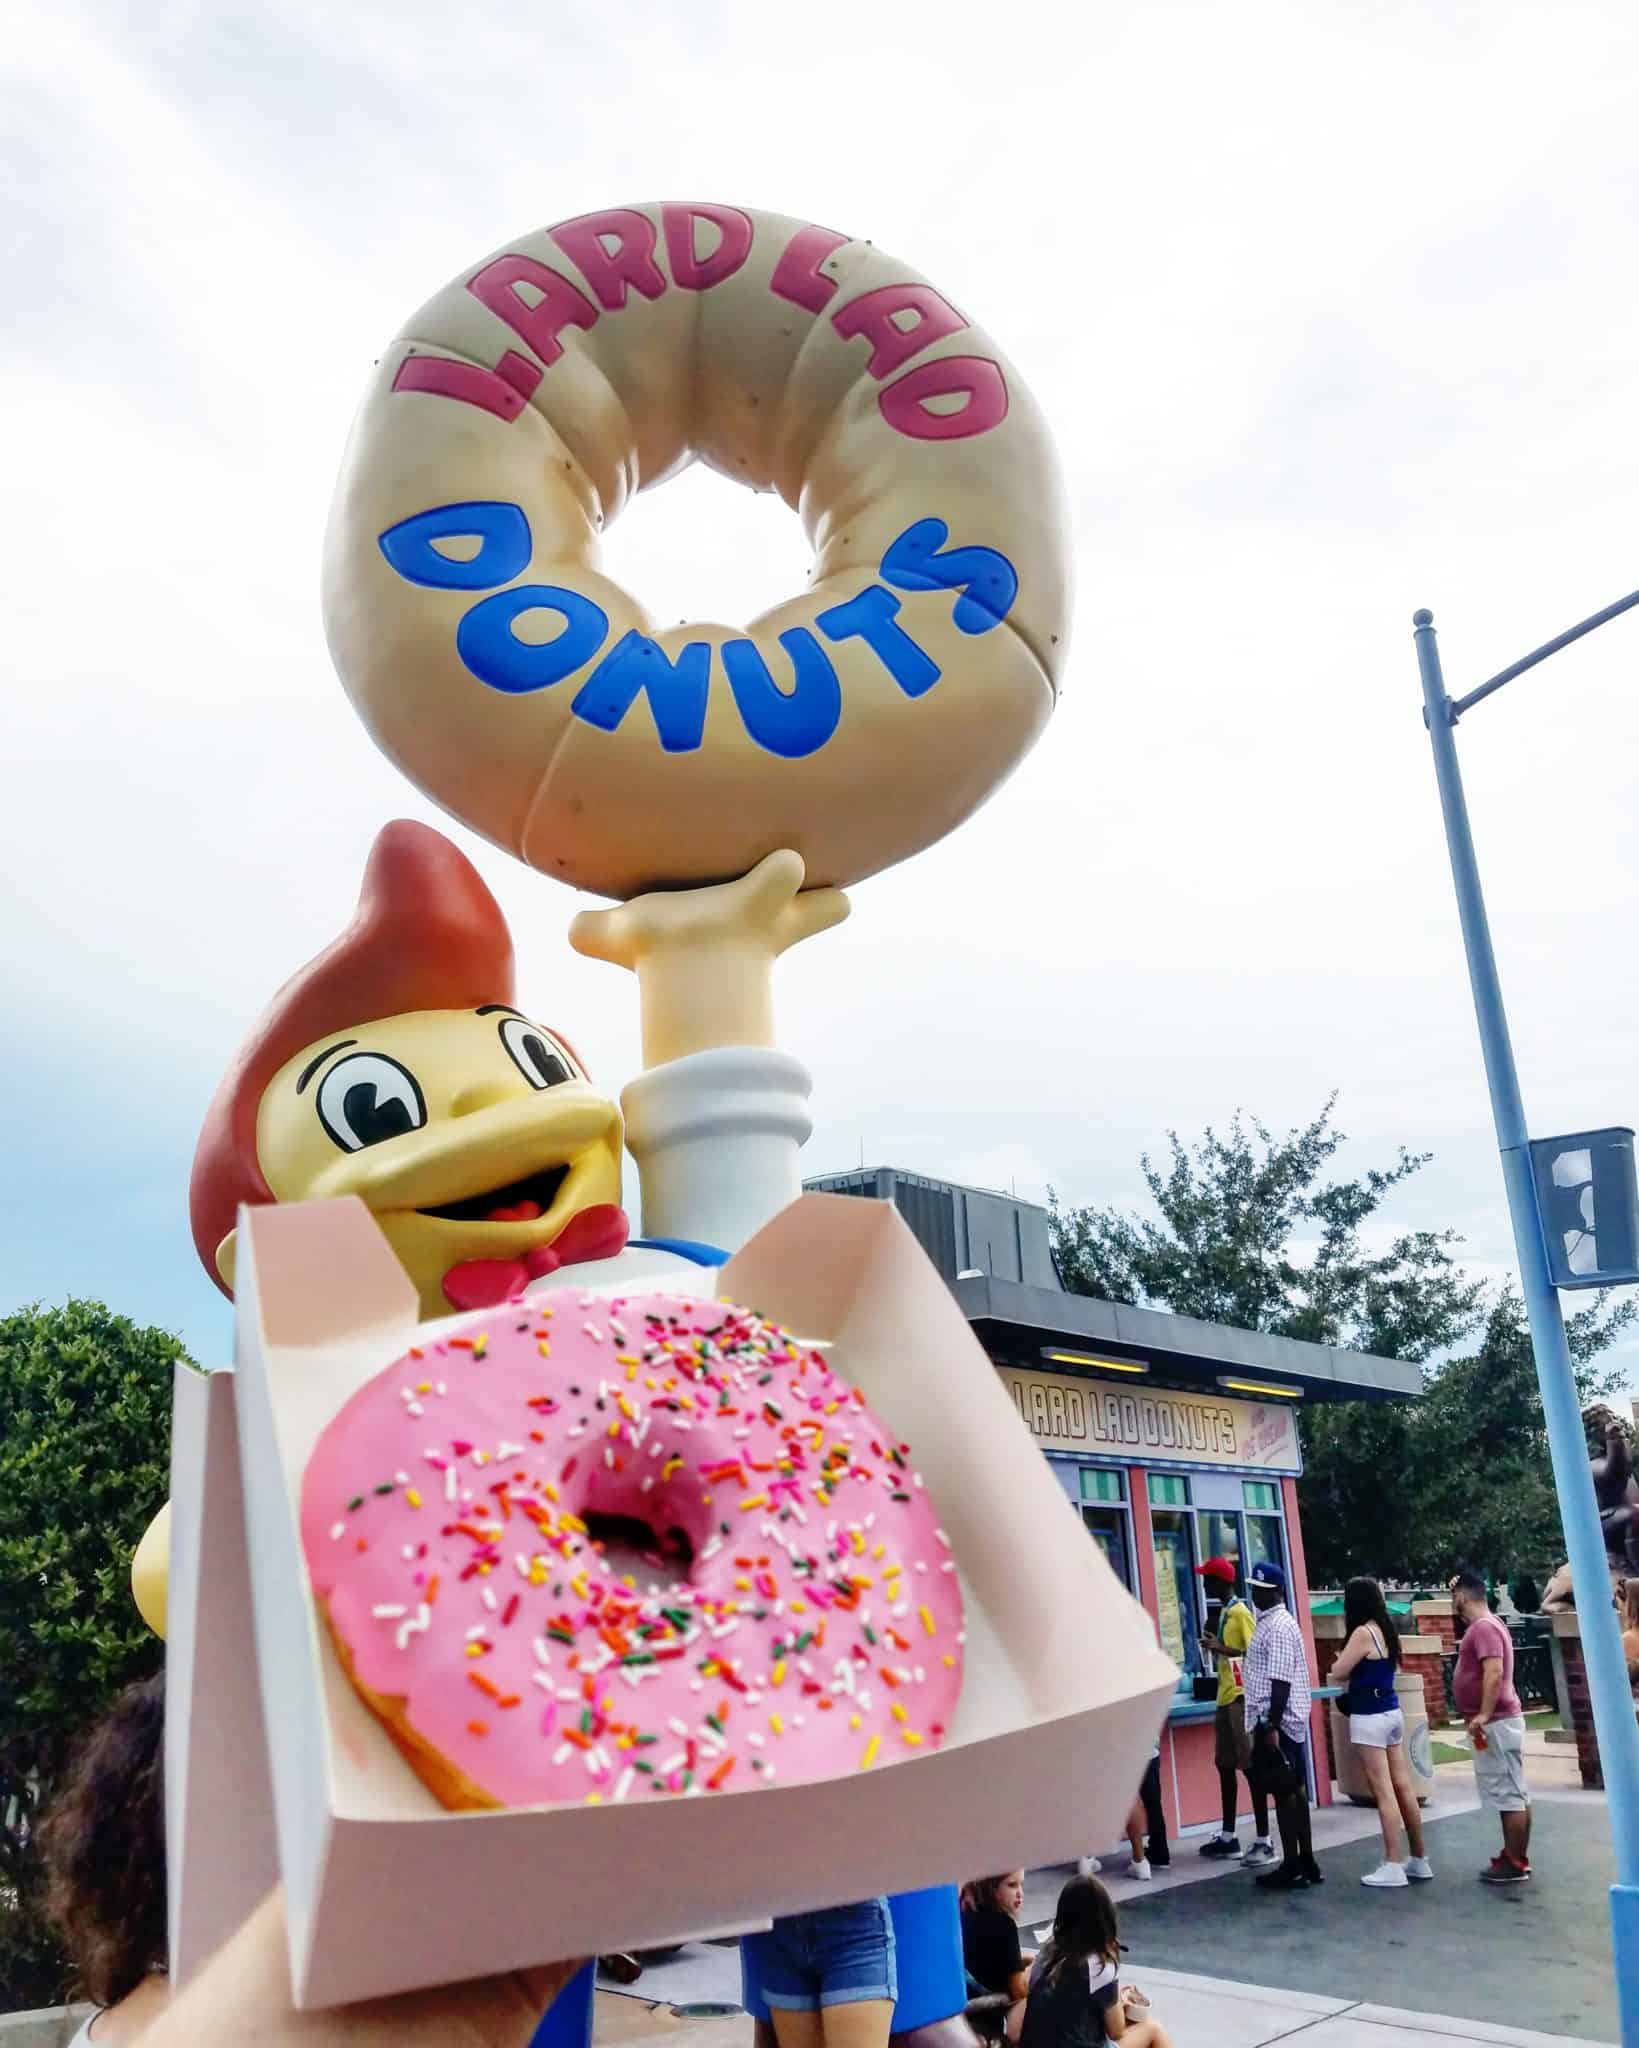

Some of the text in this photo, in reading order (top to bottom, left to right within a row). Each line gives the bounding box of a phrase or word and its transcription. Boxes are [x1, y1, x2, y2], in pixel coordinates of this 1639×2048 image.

[392, 202, 1009, 441] LARD LAD
[378, 501, 1018, 758] DONUTS
[1013, 1382, 1087, 1440] LARD
[1089, 1391, 1140, 1445] LAD
[1141, 1398, 1237, 1454] DONUTS
